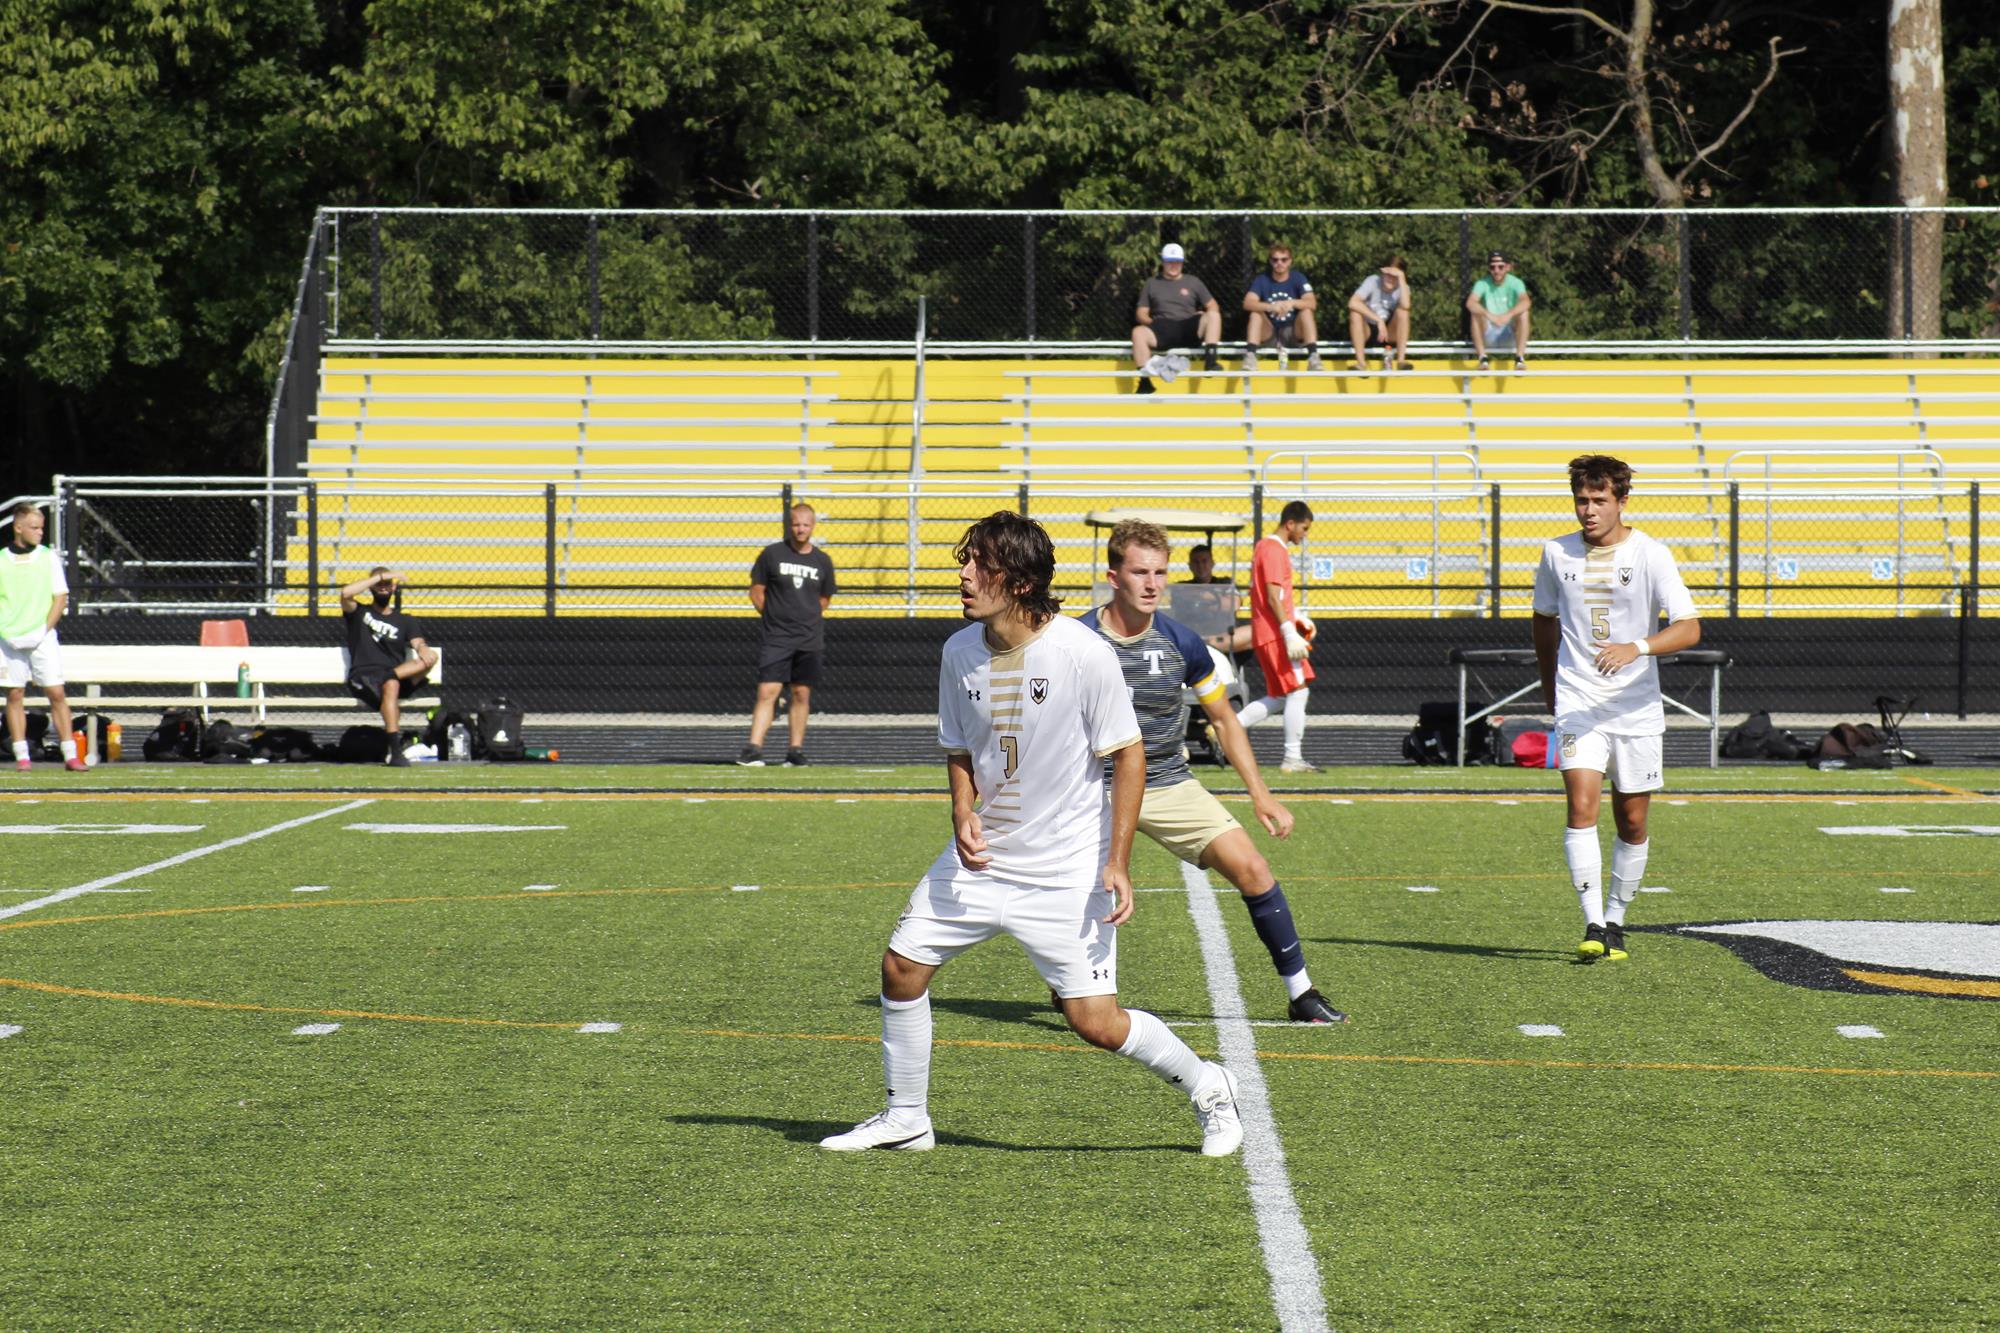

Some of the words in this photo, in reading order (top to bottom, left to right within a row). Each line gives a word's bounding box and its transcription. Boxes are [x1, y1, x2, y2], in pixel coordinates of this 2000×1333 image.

[1591, 608, 1610, 640] 5
[1143, 650, 1164, 674] T
[1000, 736, 1018, 779] 7
